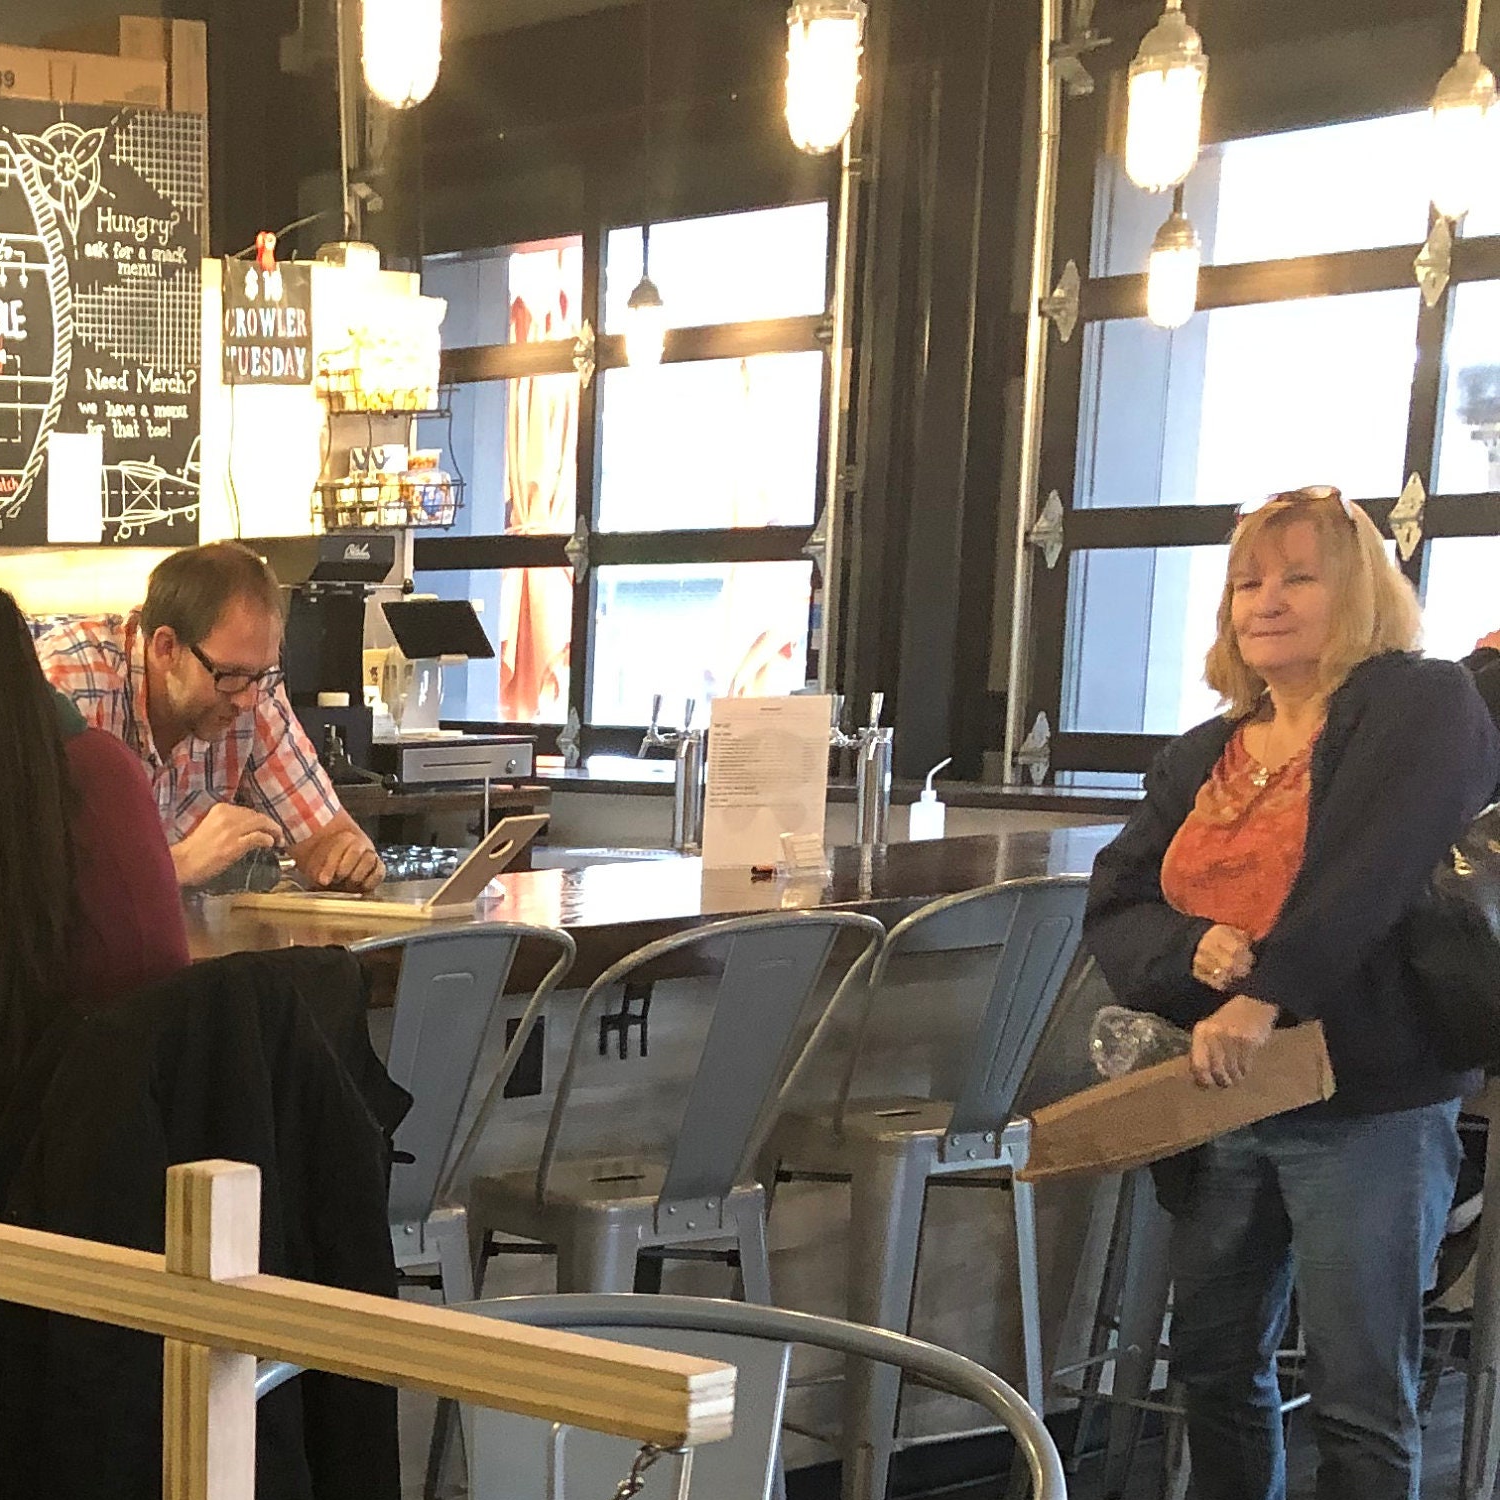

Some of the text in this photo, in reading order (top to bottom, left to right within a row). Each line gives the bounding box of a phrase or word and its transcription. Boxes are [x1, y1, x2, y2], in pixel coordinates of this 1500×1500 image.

[96, 206, 180, 246] Hungry?
[84, 240, 187, 263] ask for a snack
[117, 259, 163, 277] menu!
[224, 307, 308, 338] CROWLER
[225, 345, 307, 380] TUESDAY
[85, 367, 197, 394] Need Merch?
[77, 400, 189, 419] we have a menu
[111, 418, 140, 438] that
[146, 419, 171, 438] too!
